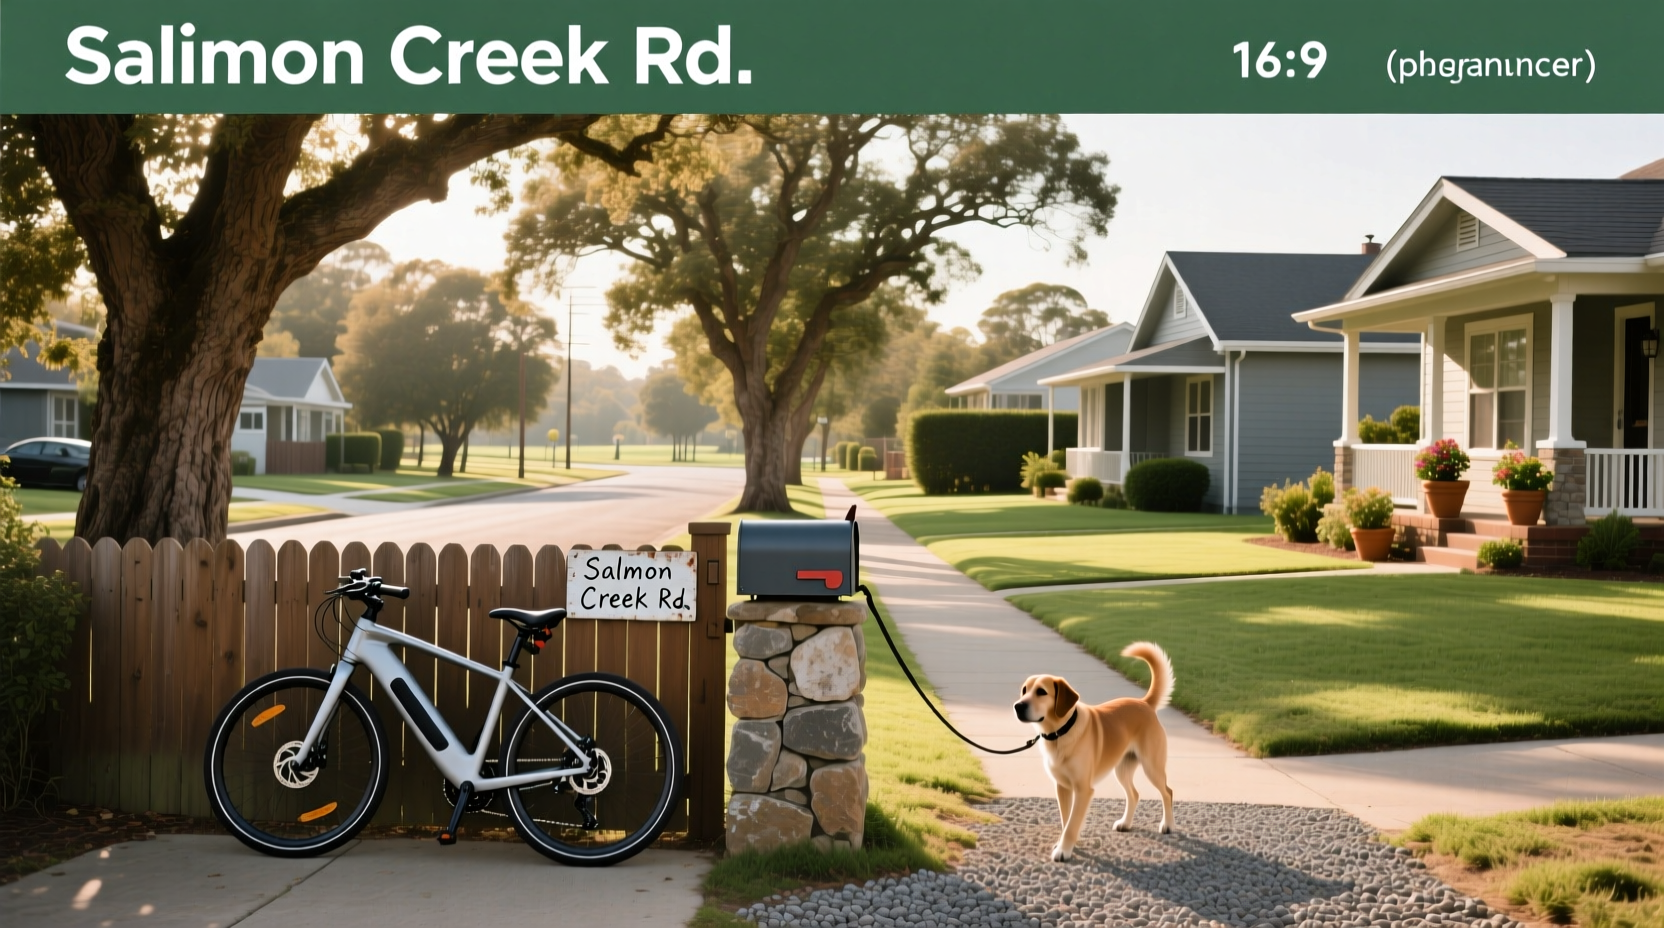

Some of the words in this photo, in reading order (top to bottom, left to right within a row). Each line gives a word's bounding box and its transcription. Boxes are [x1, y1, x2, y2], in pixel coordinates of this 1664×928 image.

[583, 555, 672, 581] Salmon
[580, 586, 648, 610] Creek
[658, 587, 691, 611] Rd.
